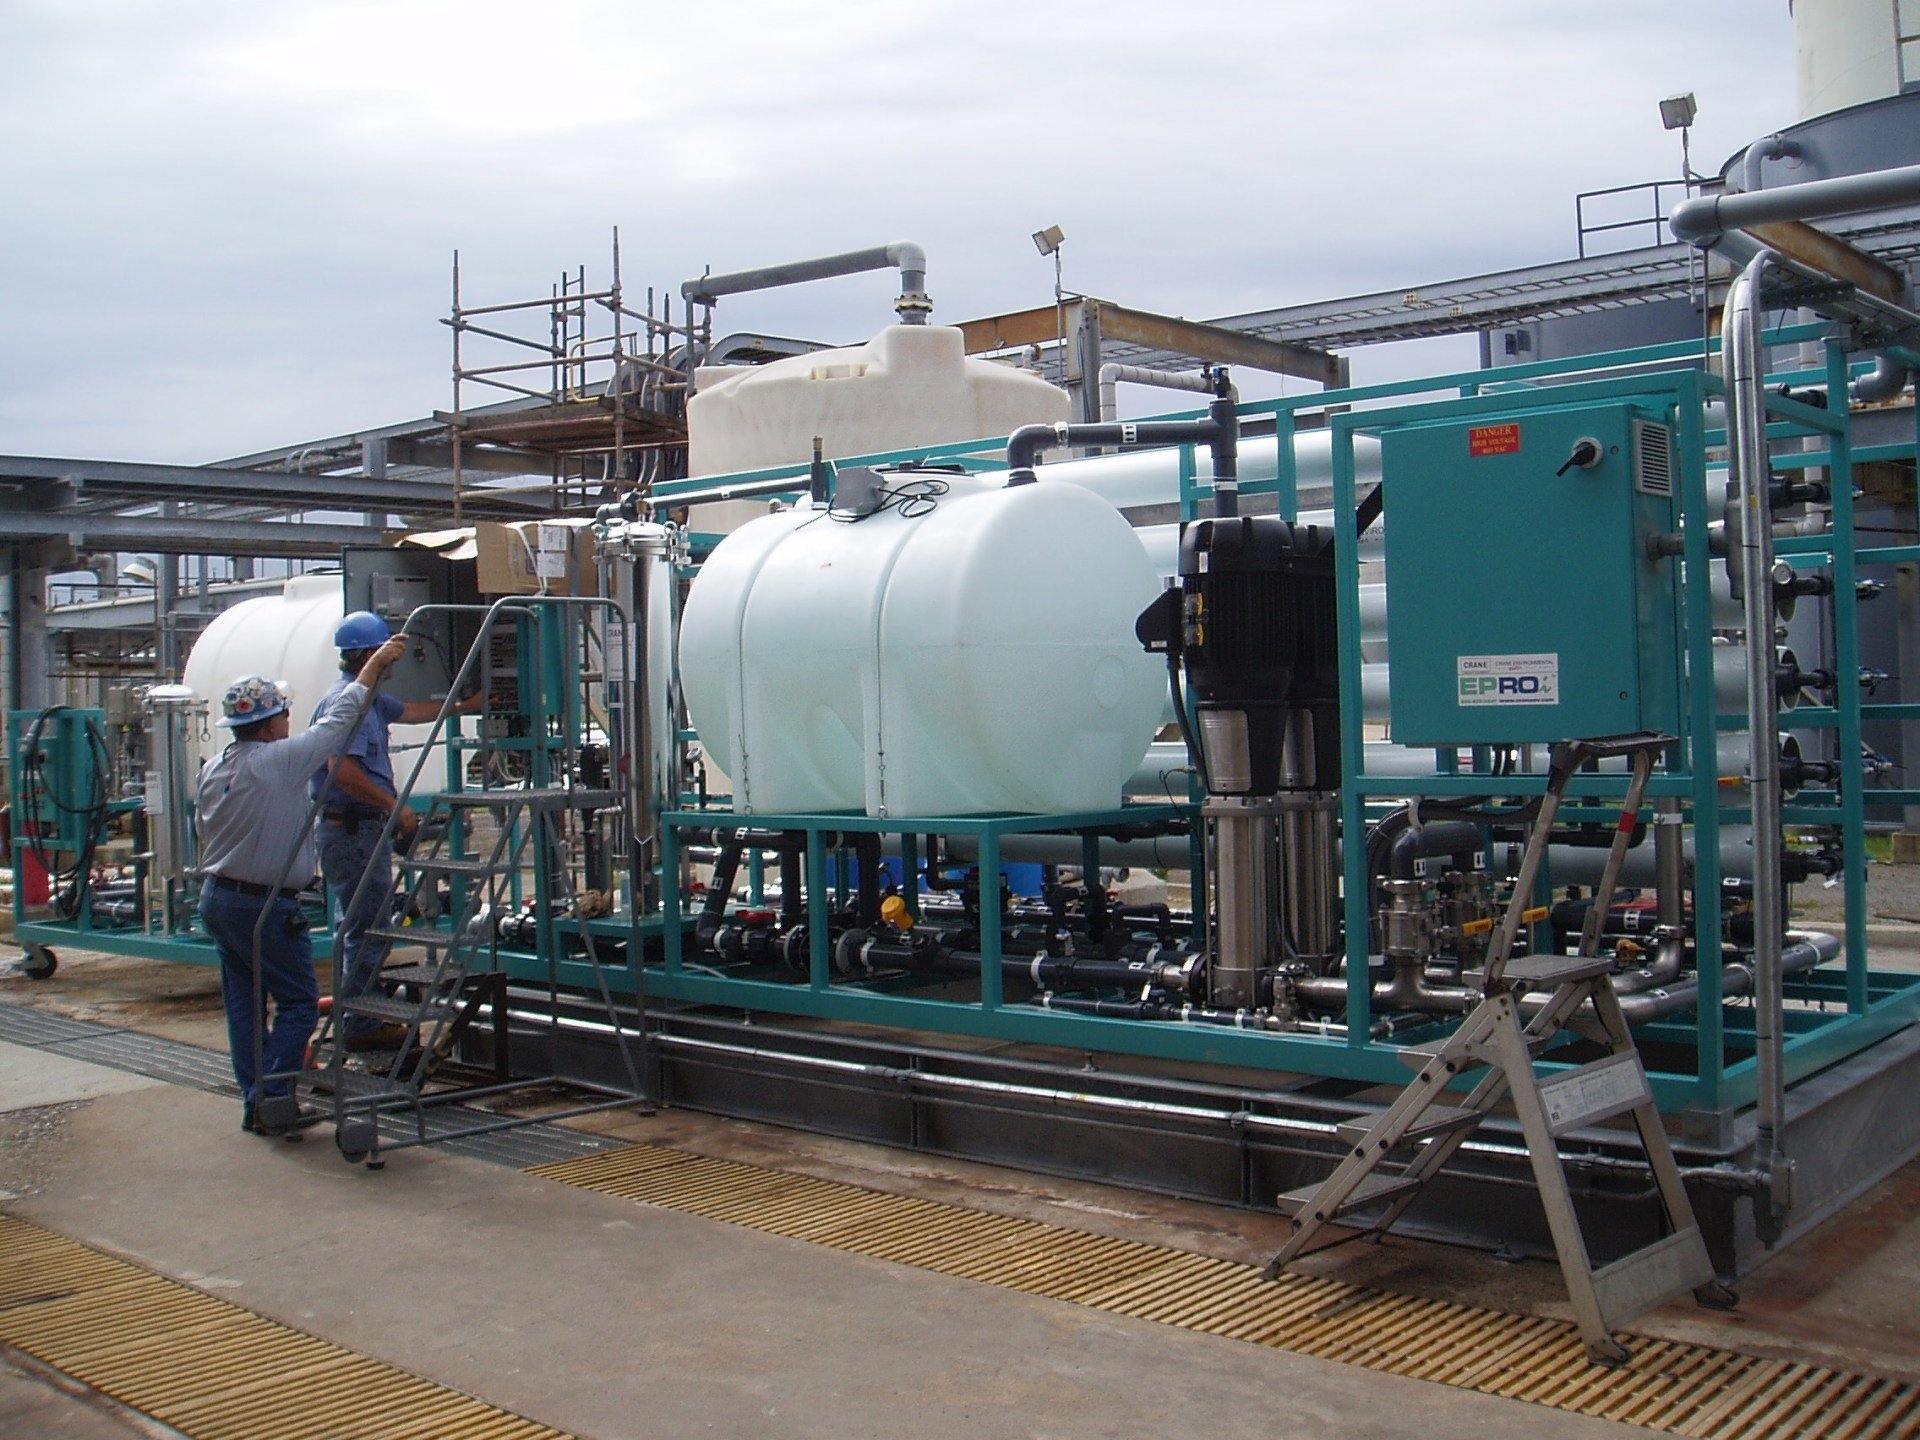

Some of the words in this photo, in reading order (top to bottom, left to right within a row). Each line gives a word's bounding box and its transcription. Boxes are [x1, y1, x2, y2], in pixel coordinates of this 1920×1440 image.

[1475, 424, 1512, 438] DANGER
[1472, 439, 1487, 448] HIGH
[1489, 436, 1517, 446] VOLTAGE
[1463, 661, 1488, 669] CRANE
